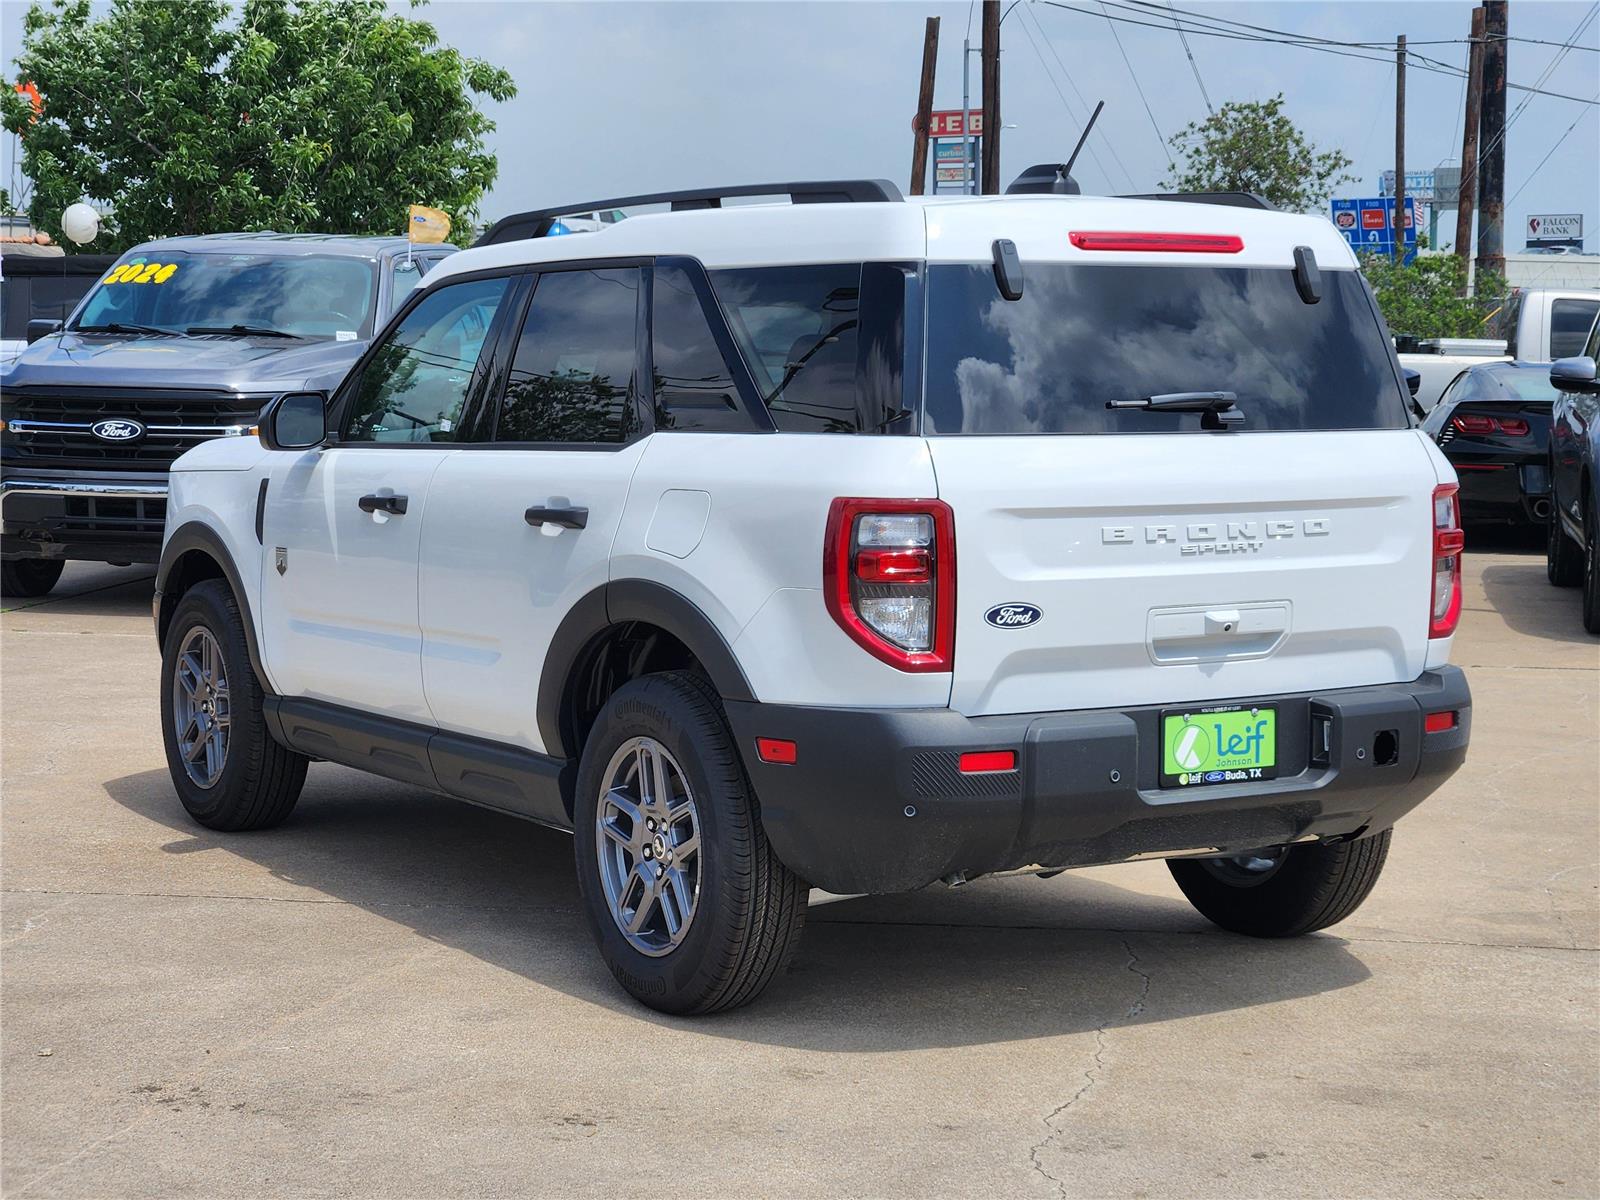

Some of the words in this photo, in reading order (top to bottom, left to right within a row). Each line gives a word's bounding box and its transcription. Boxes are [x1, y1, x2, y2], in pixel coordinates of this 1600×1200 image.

[1543, 217, 1579, 226] FALCON
[1543, 226, 1569, 234] BANK
[103, 263, 178, 284] 2024
[101, 420, 132, 439] Ford
[1102, 519, 1330, 545] BRONCO
[1181, 542, 1264, 556] SPORT
[996, 607, 1032, 626] Ford
[1214, 720, 1267, 763] leif
[1216, 758, 1252, 767] Johnson
[1225, 770, 1248, 780] Buda,
[1250, 768, 1262, 778] TX
